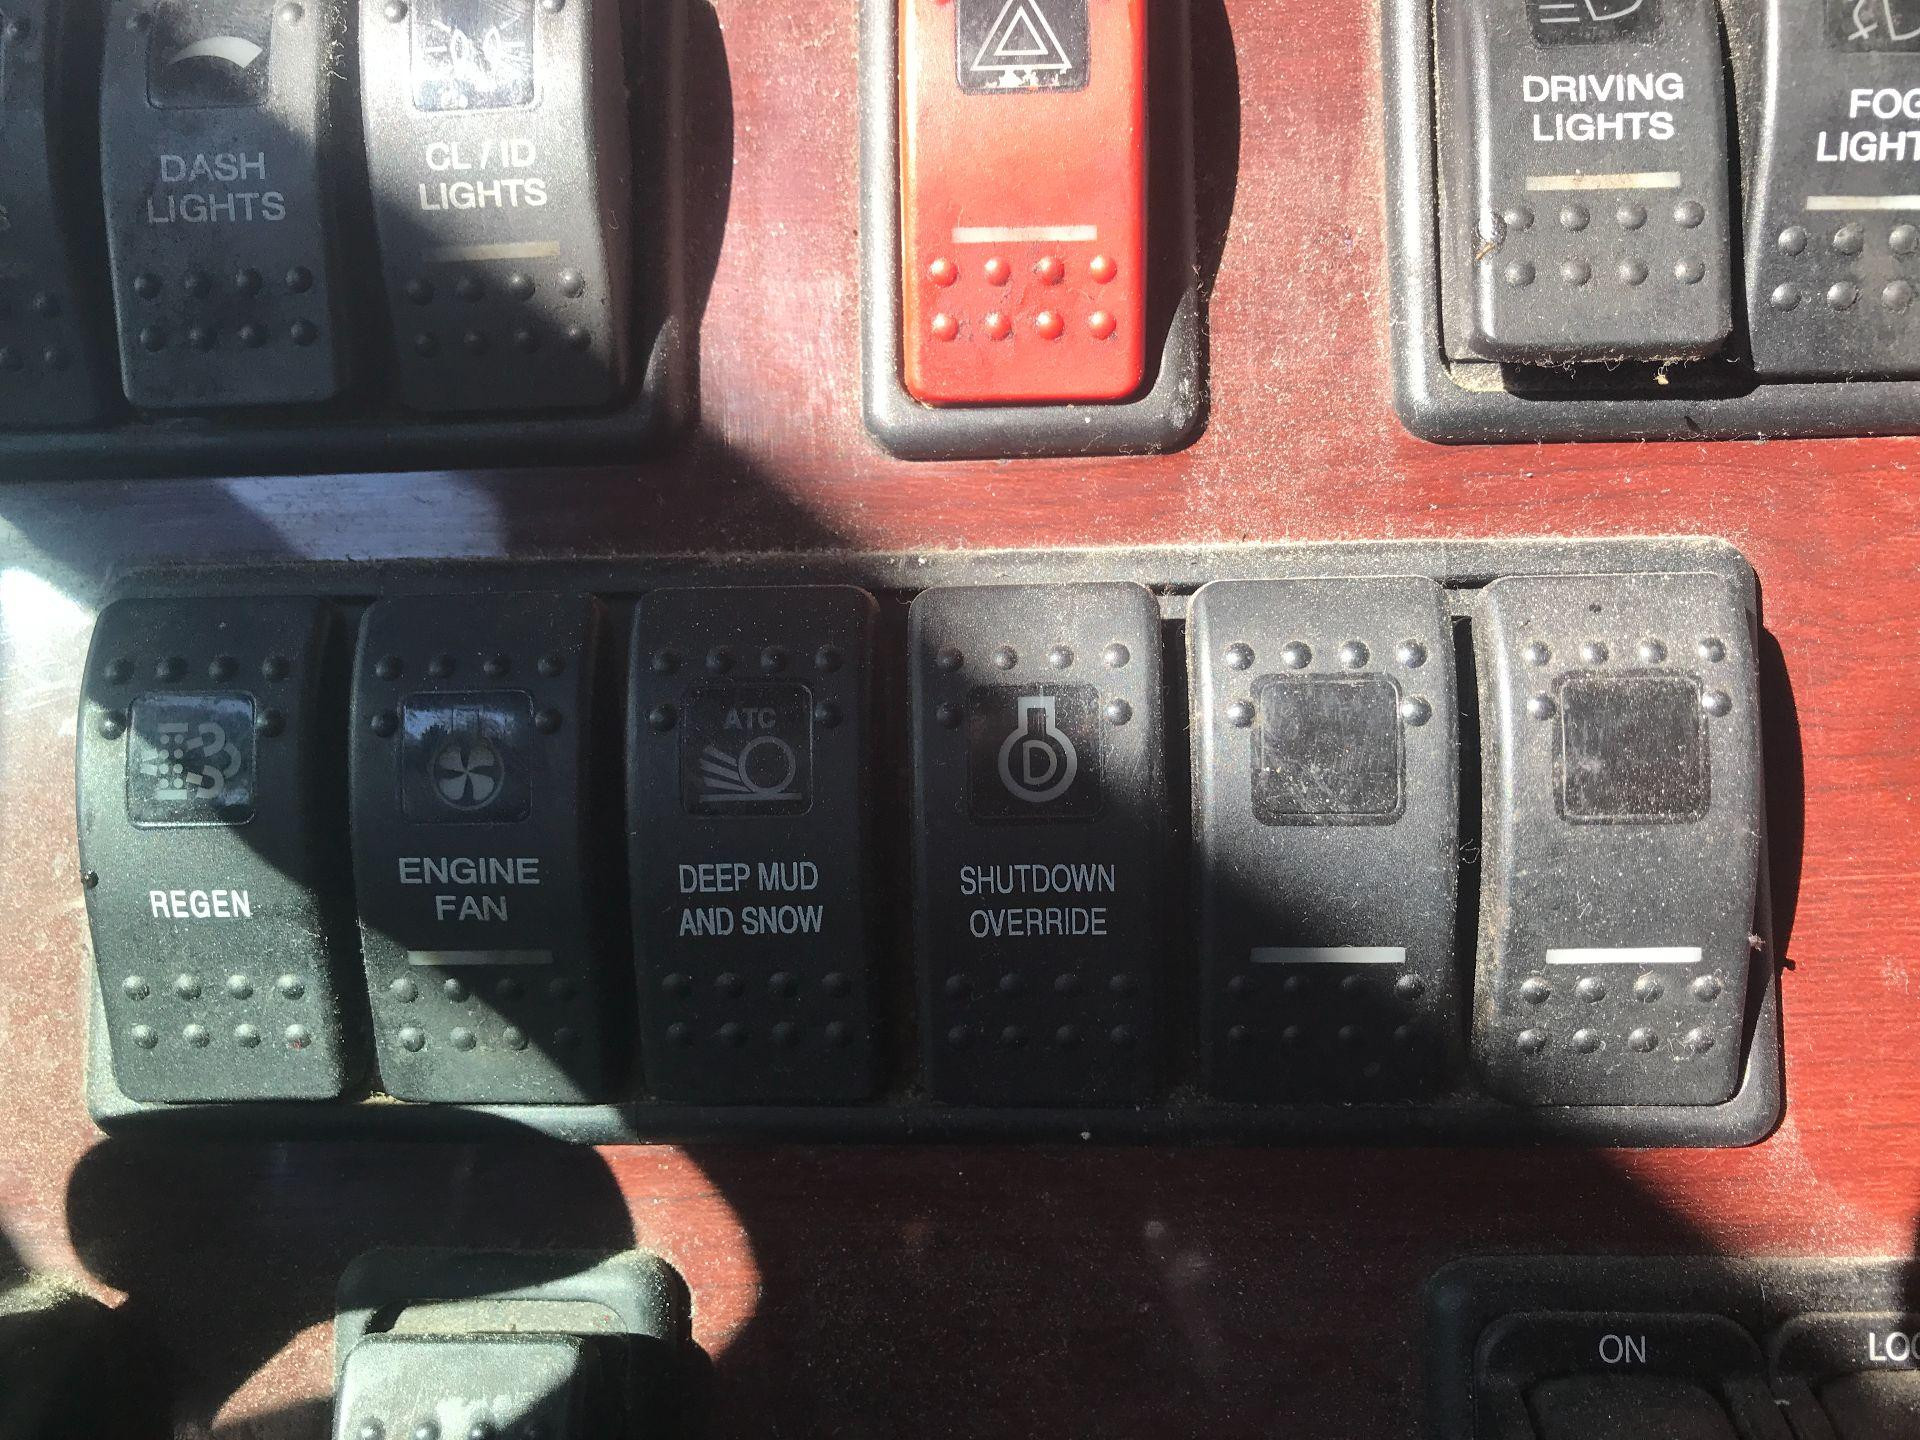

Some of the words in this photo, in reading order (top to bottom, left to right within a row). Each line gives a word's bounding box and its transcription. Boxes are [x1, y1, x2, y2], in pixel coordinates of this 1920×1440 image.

[1522, 72, 1684, 103] DRIVING
[1849, 87, 1920, 119] FOG
[1533, 111, 1675, 142] LIGHTS
[160, 151, 266, 183] DASH
[147, 191, 286, 224] LIGHTS
[418, 177, 548, 211] LIGHTS
[724, 706, 777, 730] ATC
[398, 856, 541, 885] ENGINE
[678, 863, 751, 893] DEEP
[757, 861, 819, 892] MUD
[959, 863, 1115, 895] SHUTDOWN
[148, 889, 252, 919] REGEN
[435, 895, 509, 922] FAN
[679, 906, 735, 937] AND
[741, 904, 824, 935] SNOW
[969, 907, 1108, 938] OVERRIDE
[1598, 1333, 1647, 1364] ON
